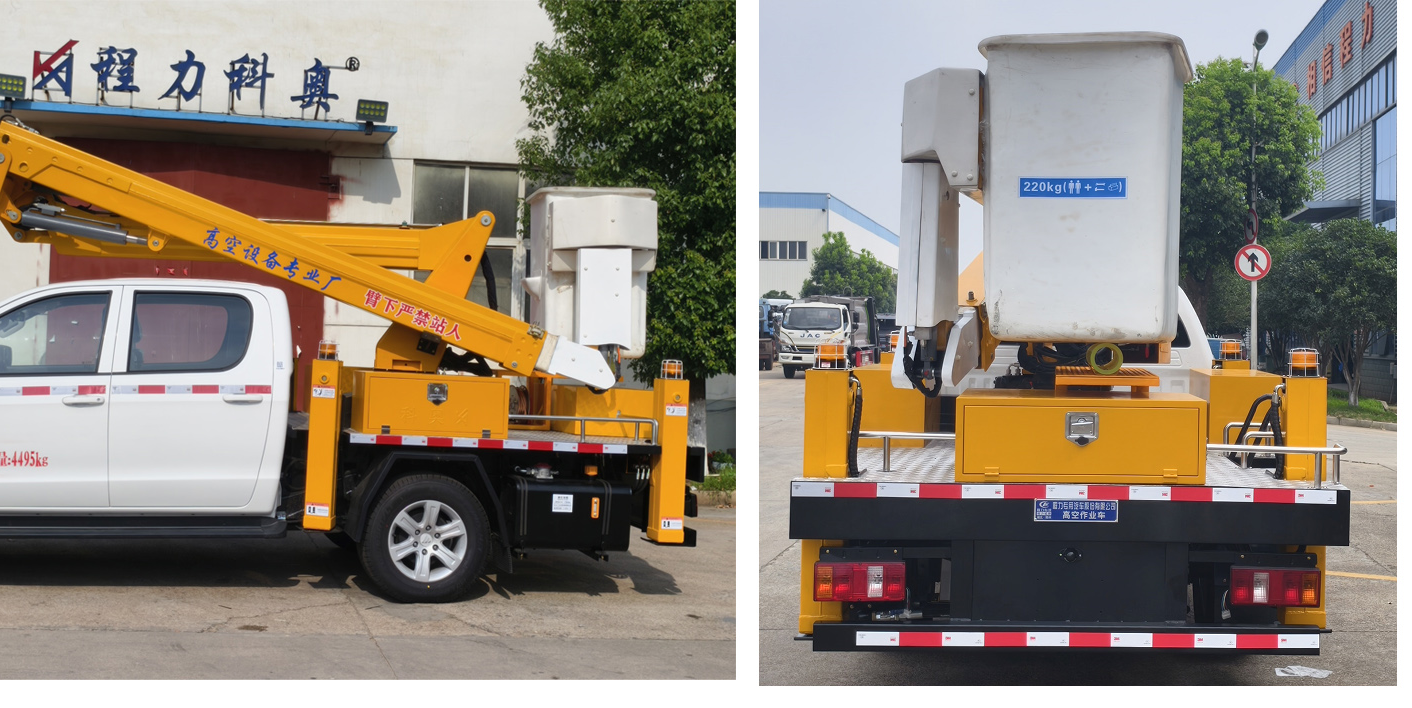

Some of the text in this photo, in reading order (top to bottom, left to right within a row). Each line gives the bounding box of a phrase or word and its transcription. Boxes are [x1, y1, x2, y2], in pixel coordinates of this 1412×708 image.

[90, 46, 339, 111] 程力科奥
[1292, 0, 1374, 100] 相信程力
[203, 227, 342, 291] 高空设备专业厂
[364, 289, 462, 341] 臂下严禁站人
[1062, 510, 1106, 520] 高空作业车
